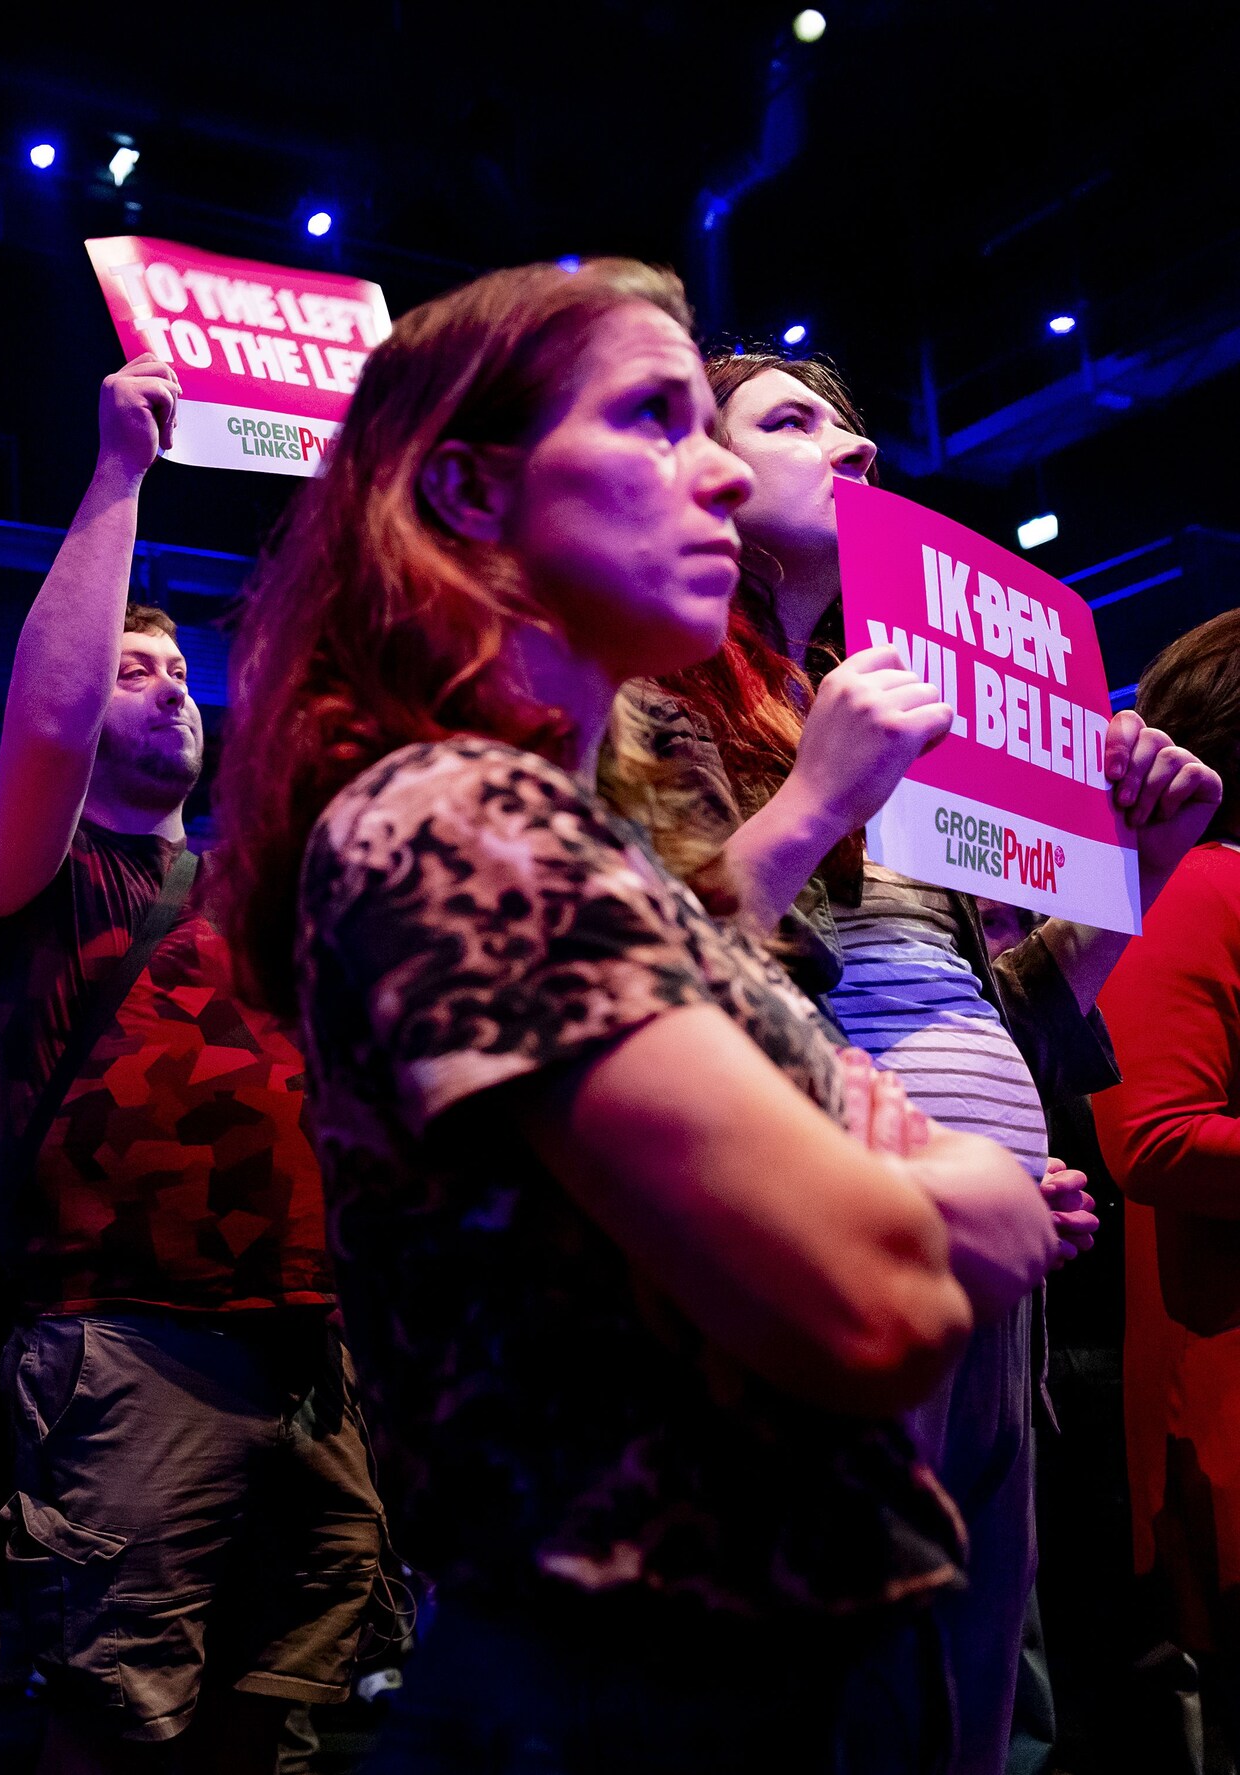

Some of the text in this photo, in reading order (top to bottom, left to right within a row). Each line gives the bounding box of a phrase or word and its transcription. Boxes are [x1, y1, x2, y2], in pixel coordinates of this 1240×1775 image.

[109, 262, 189, 313] TO
[184, 269, 287, 332] THE
[133, 317, 368, 395] TO THE LE
[227, 416, 299, 443] GROEN
[241, 437, 302, 461] LINKS
[298, 426, 329, 462] Pv
[922, 543, 1072, 686] IK BEN
[974, 660, 1113, 791] BELEID
[934, 806, 1003, 851] GROEN
[945, 837, 1003, 878] LINKS
[1003, 827, 1057, 895] PvdA
